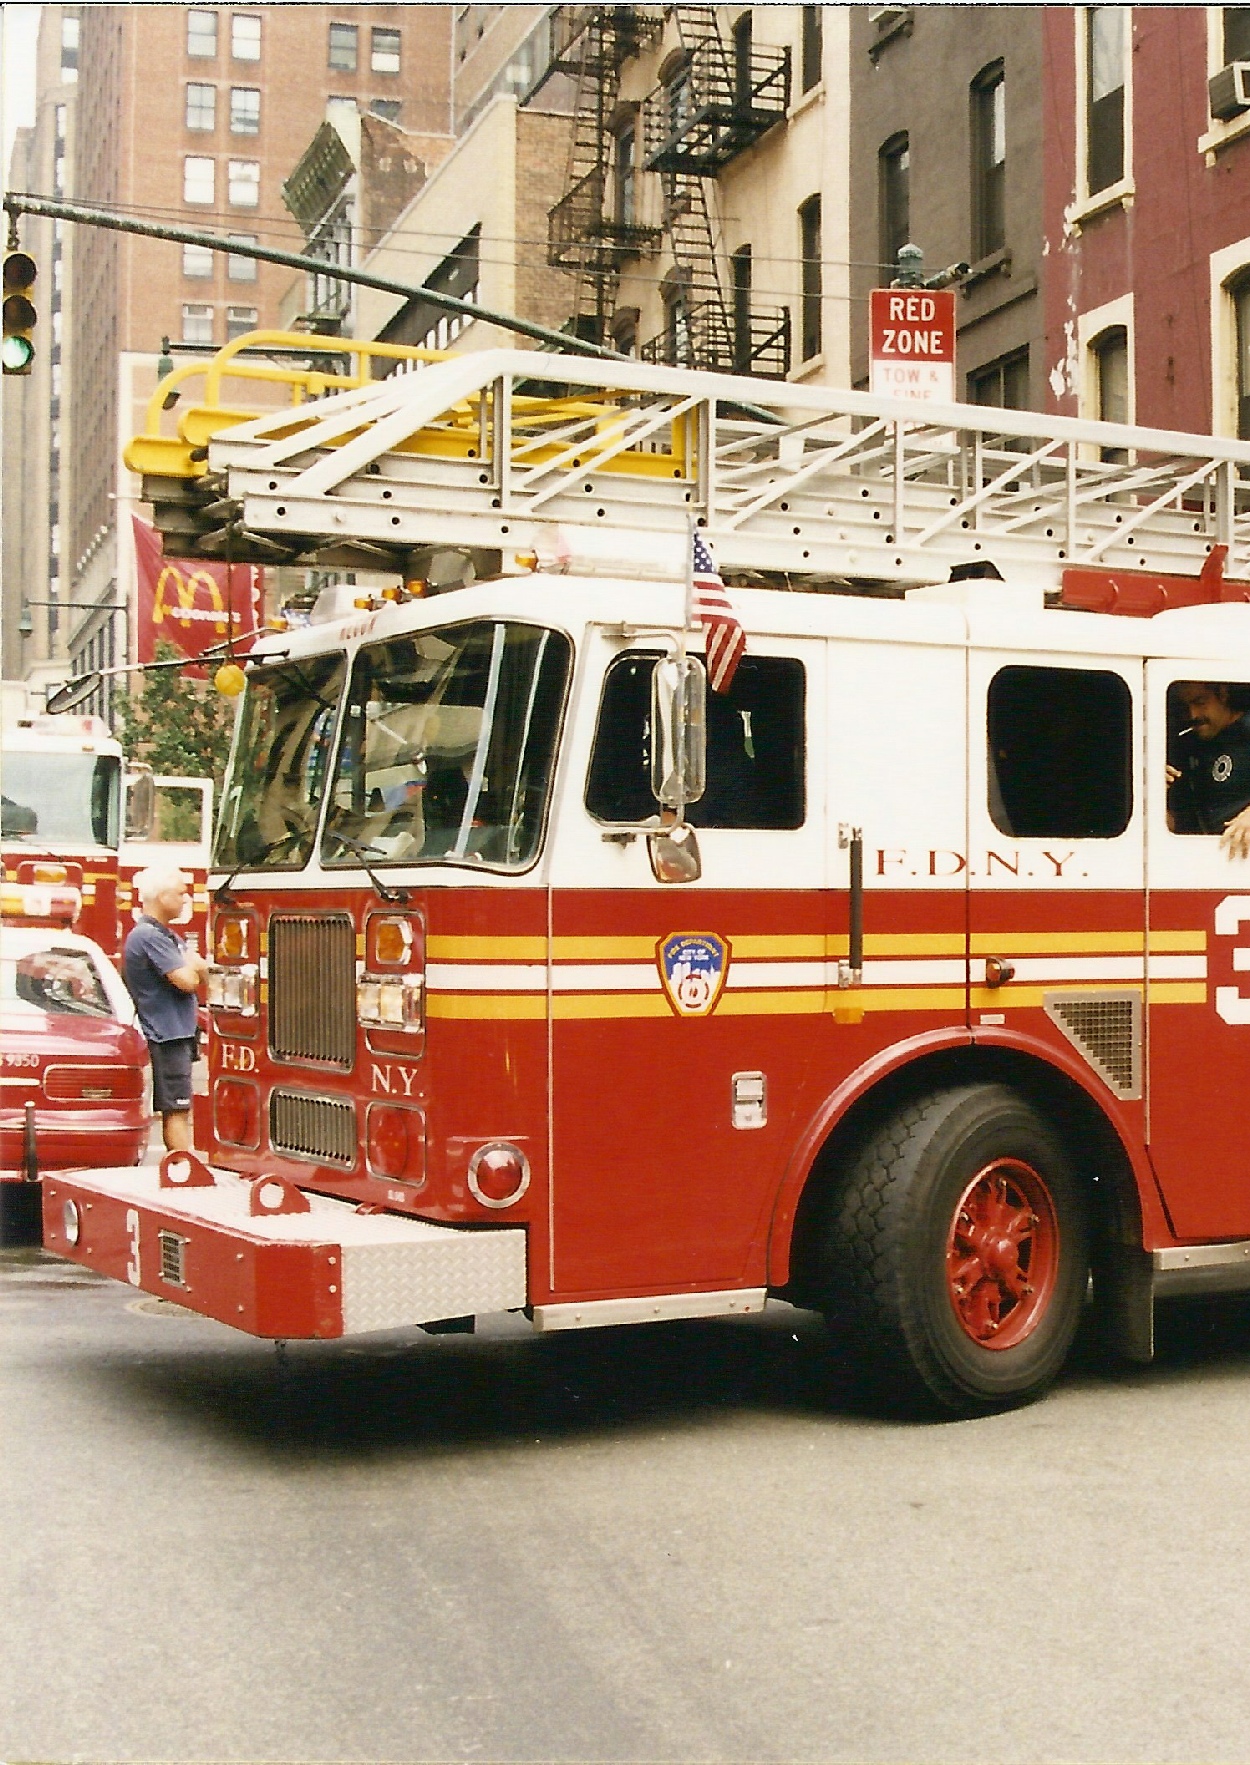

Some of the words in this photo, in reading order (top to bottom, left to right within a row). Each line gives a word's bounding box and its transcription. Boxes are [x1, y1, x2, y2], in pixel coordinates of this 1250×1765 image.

[889, 297, 936, 321] RED
[882, 329, 944, 354] ZONE
[884, 367, 921, 384] TOW
[221, 1043, 261, 1074] F.D.
[371, 1063, 425, 1098] N.Y.
[126, 1208, 142, 1288] 3
